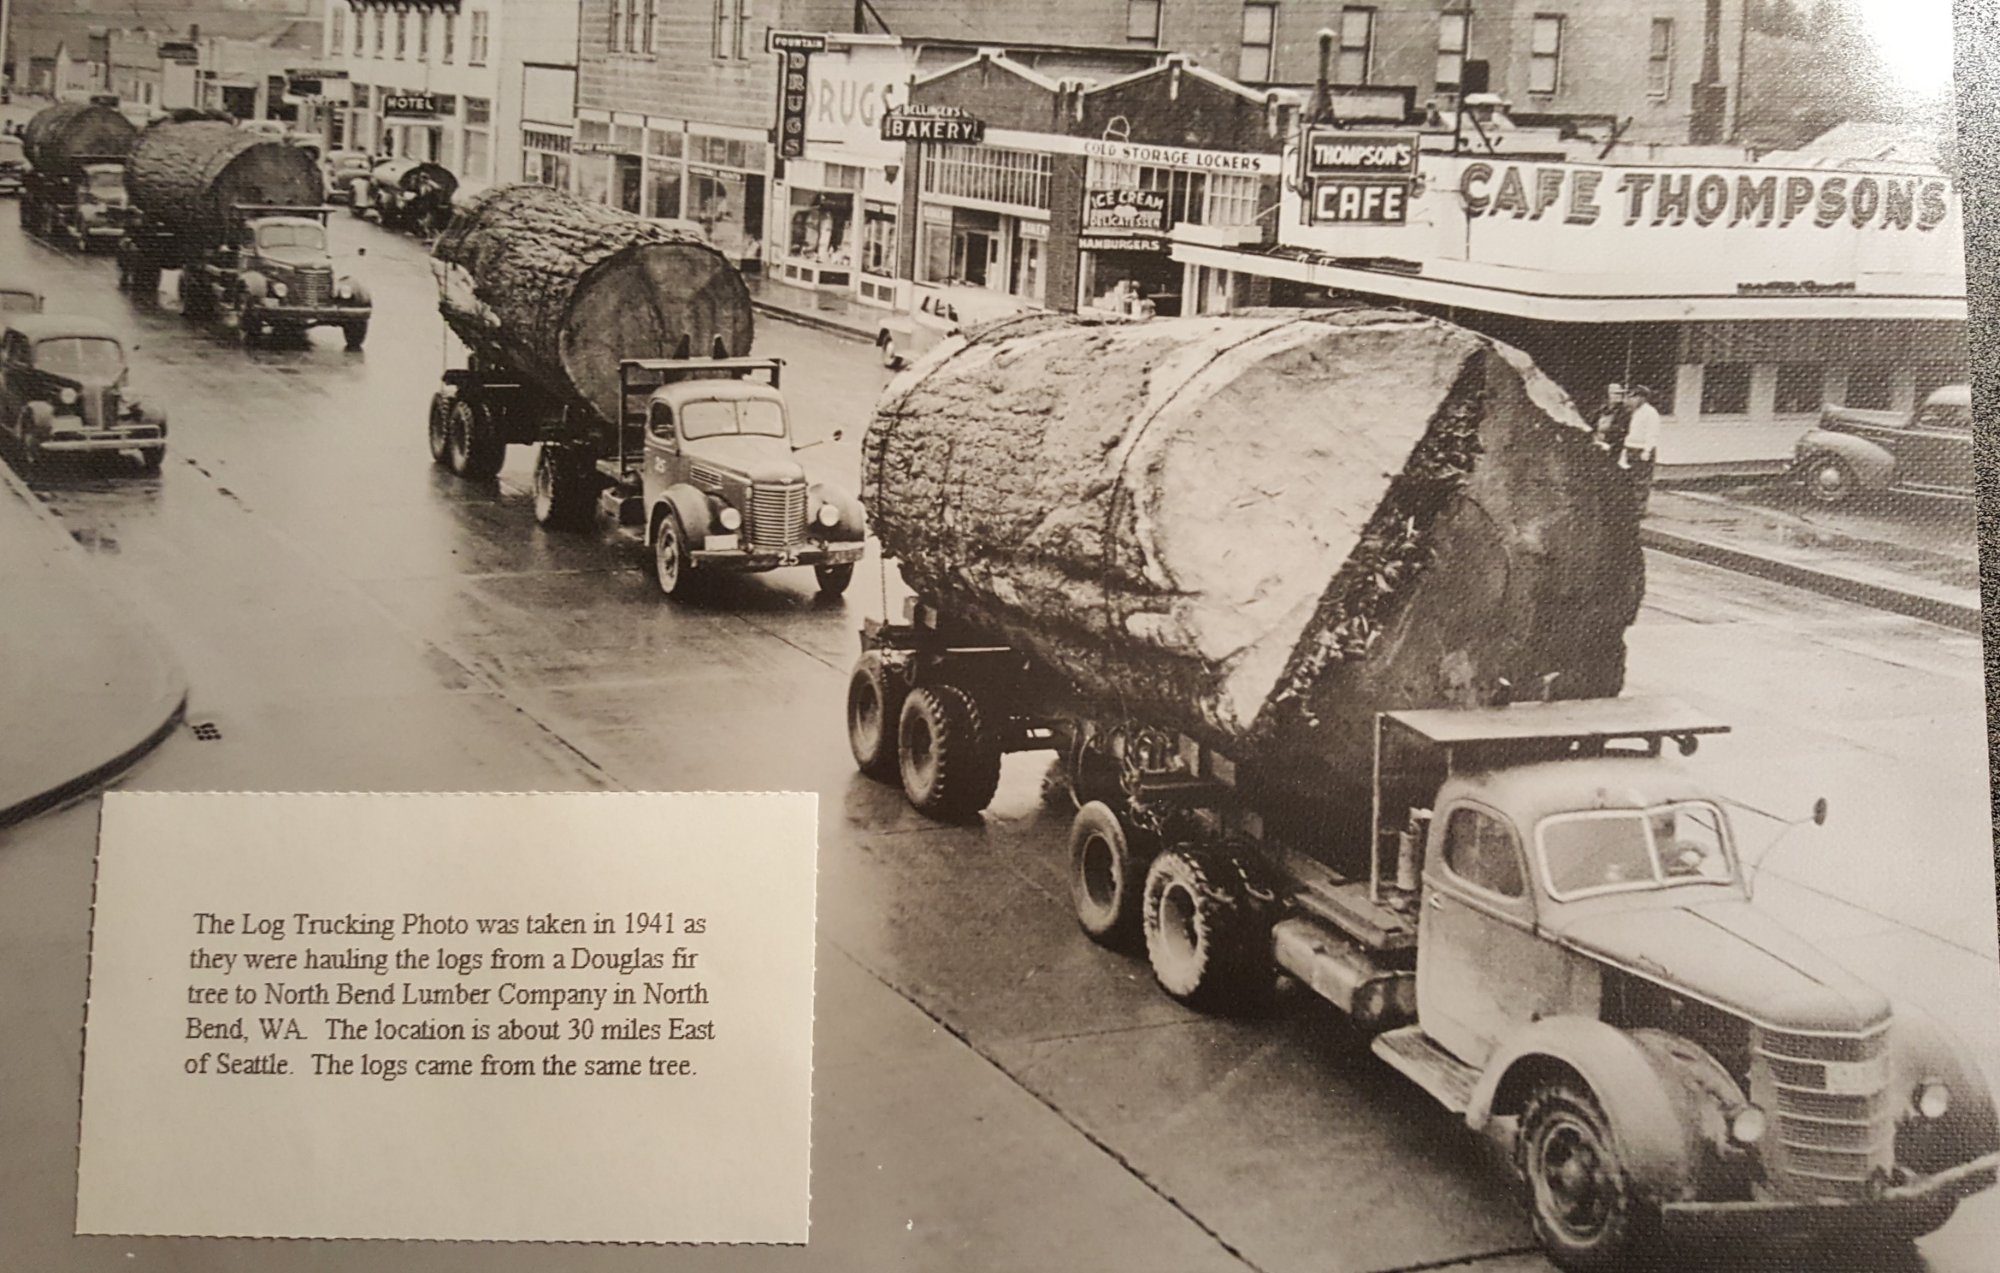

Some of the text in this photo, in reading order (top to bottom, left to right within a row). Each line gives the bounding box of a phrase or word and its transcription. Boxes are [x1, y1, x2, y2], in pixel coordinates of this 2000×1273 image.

[775, 37, 823, 48] FOUNTAIN
[387, 97, 434, 110] HOTEL
[785, 52, 806, 155] DRUGS
[892, 120, 972, 139] BAKERY
[1084, 142, 1262, 171] COLD STORAGE LOCKERS
[1313, 143, 1412, 166] THOMPSON'S
[1092, 189, 1165, 210] ICE CREAM
[1317, 186, 1404, 220] CAFE
[1460, 163, 1948, 232] CAFE THOMPSON'S
[1078, 238, 1160, 251] HAMBURGERS
[778, 551, 800, 566] 25
[192, 911, 707, 941] The Log Trucking Photo was taken in 1941 as
[189, 946, 699, 976] they were hauling the logs from a Douglas fir
[187, 981, 710, 1011] tree to North Bend Lumber Company in North
[185, 1016, 249, 1043] Bend,
[324, 1018, 369, 1041] The
[374, 1017, 466, 1040] location
[471, 1017, 491, 1041] is
[497, 1018, 561, 1041] about
[567, 1017, 595, 1041] 30
[600, 1017, 662, 1041] miles
[667, 1017, 716, 1041] East
[184, 1052, 698, 1082] of Seattle. The logs came from the same tree.
